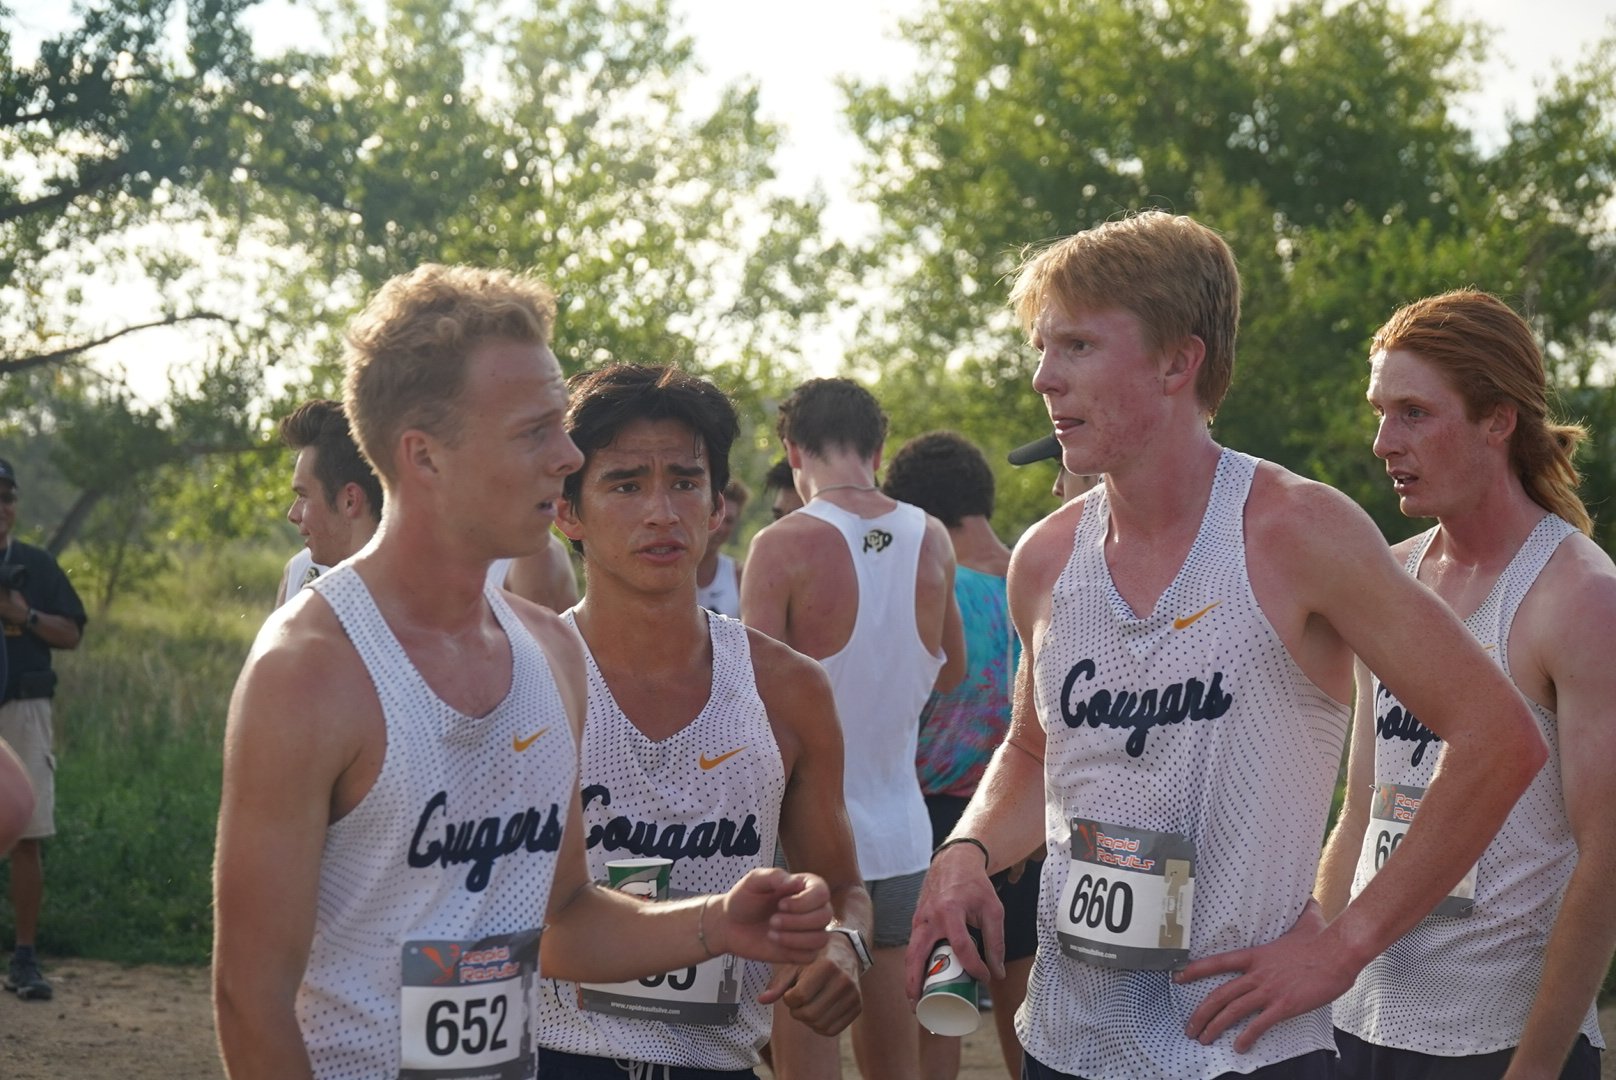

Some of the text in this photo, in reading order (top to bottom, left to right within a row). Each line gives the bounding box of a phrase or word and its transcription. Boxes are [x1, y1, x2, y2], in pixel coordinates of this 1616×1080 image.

[1061, 659, 1232, 758] Cougars
[582, 784, 761, 873] Cougars
[1096, 832, 1140, 852] Rapid
[1096, 847, 1155, 870] Results
[1069, 873, 1133, 934] 660
[462, 946, 510, 965] Rapid
[425, 995, 508, 1056] 652
